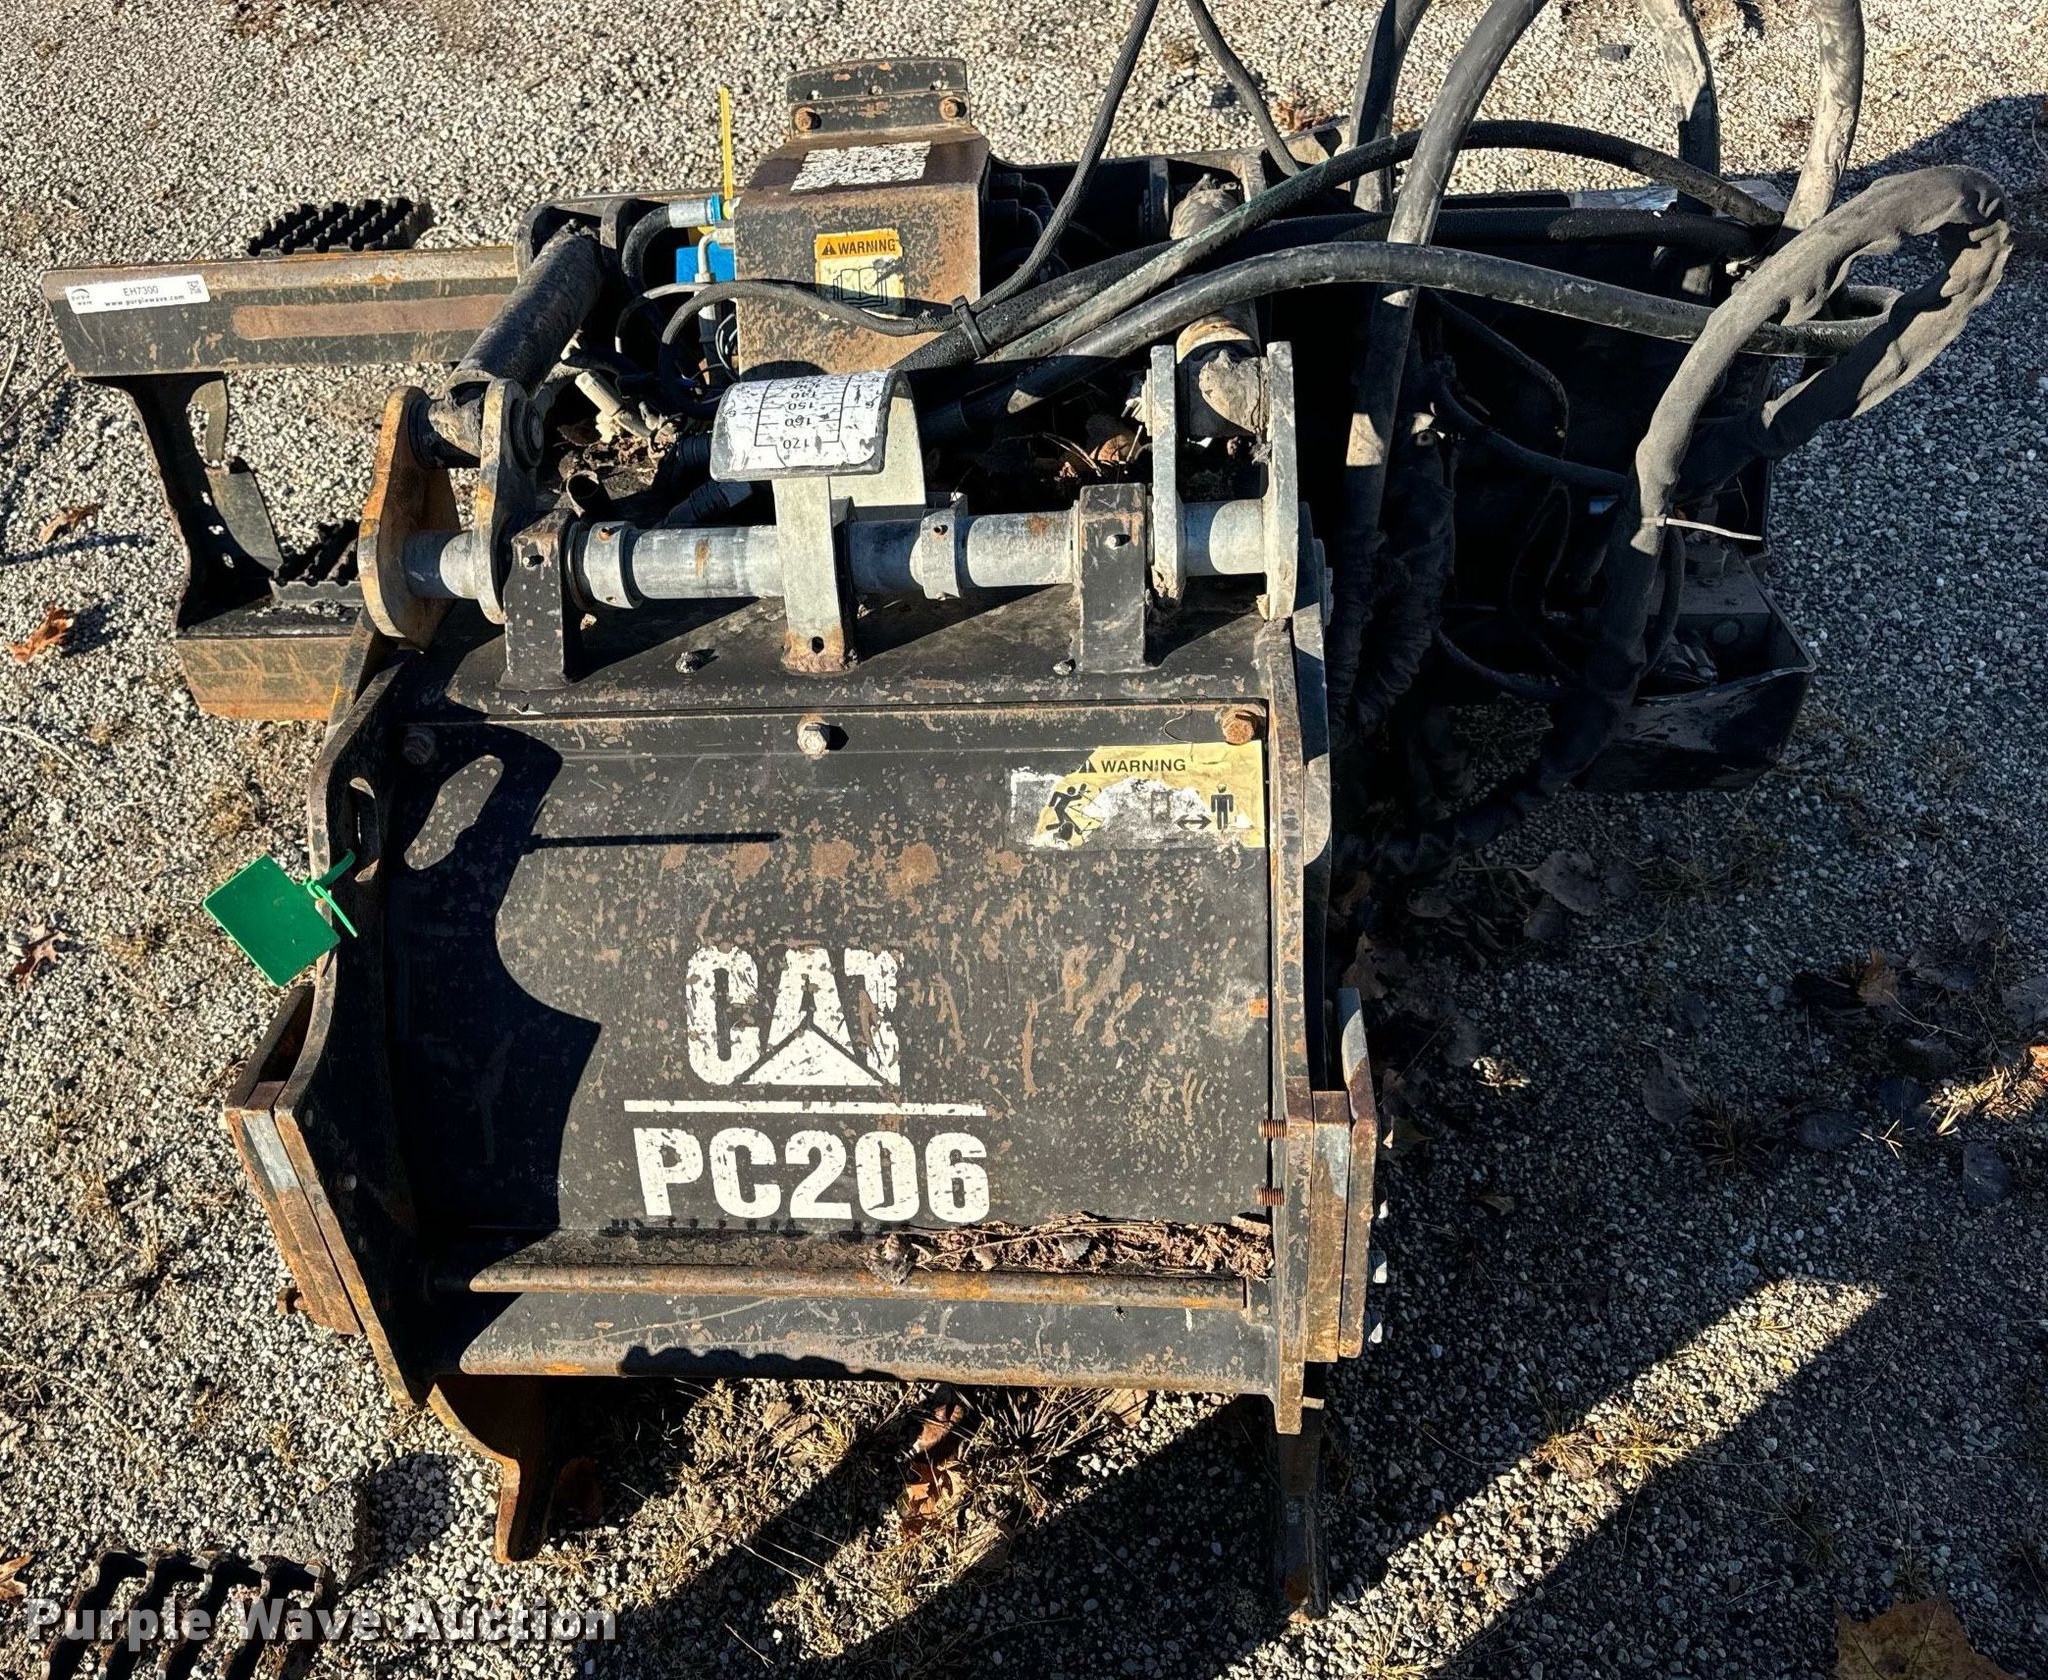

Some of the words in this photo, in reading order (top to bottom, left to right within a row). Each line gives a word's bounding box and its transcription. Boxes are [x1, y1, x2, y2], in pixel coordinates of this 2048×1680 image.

[837, 238, 897, 255] WARNING
[123, 285, 159, 297] EH7300
[784, 415, 813, 428] 160
[1101, 758, 1186, 773] WARNING
[686, 946, 901, 1086] CAT
[633, 1127, 990, 1223] PC206
